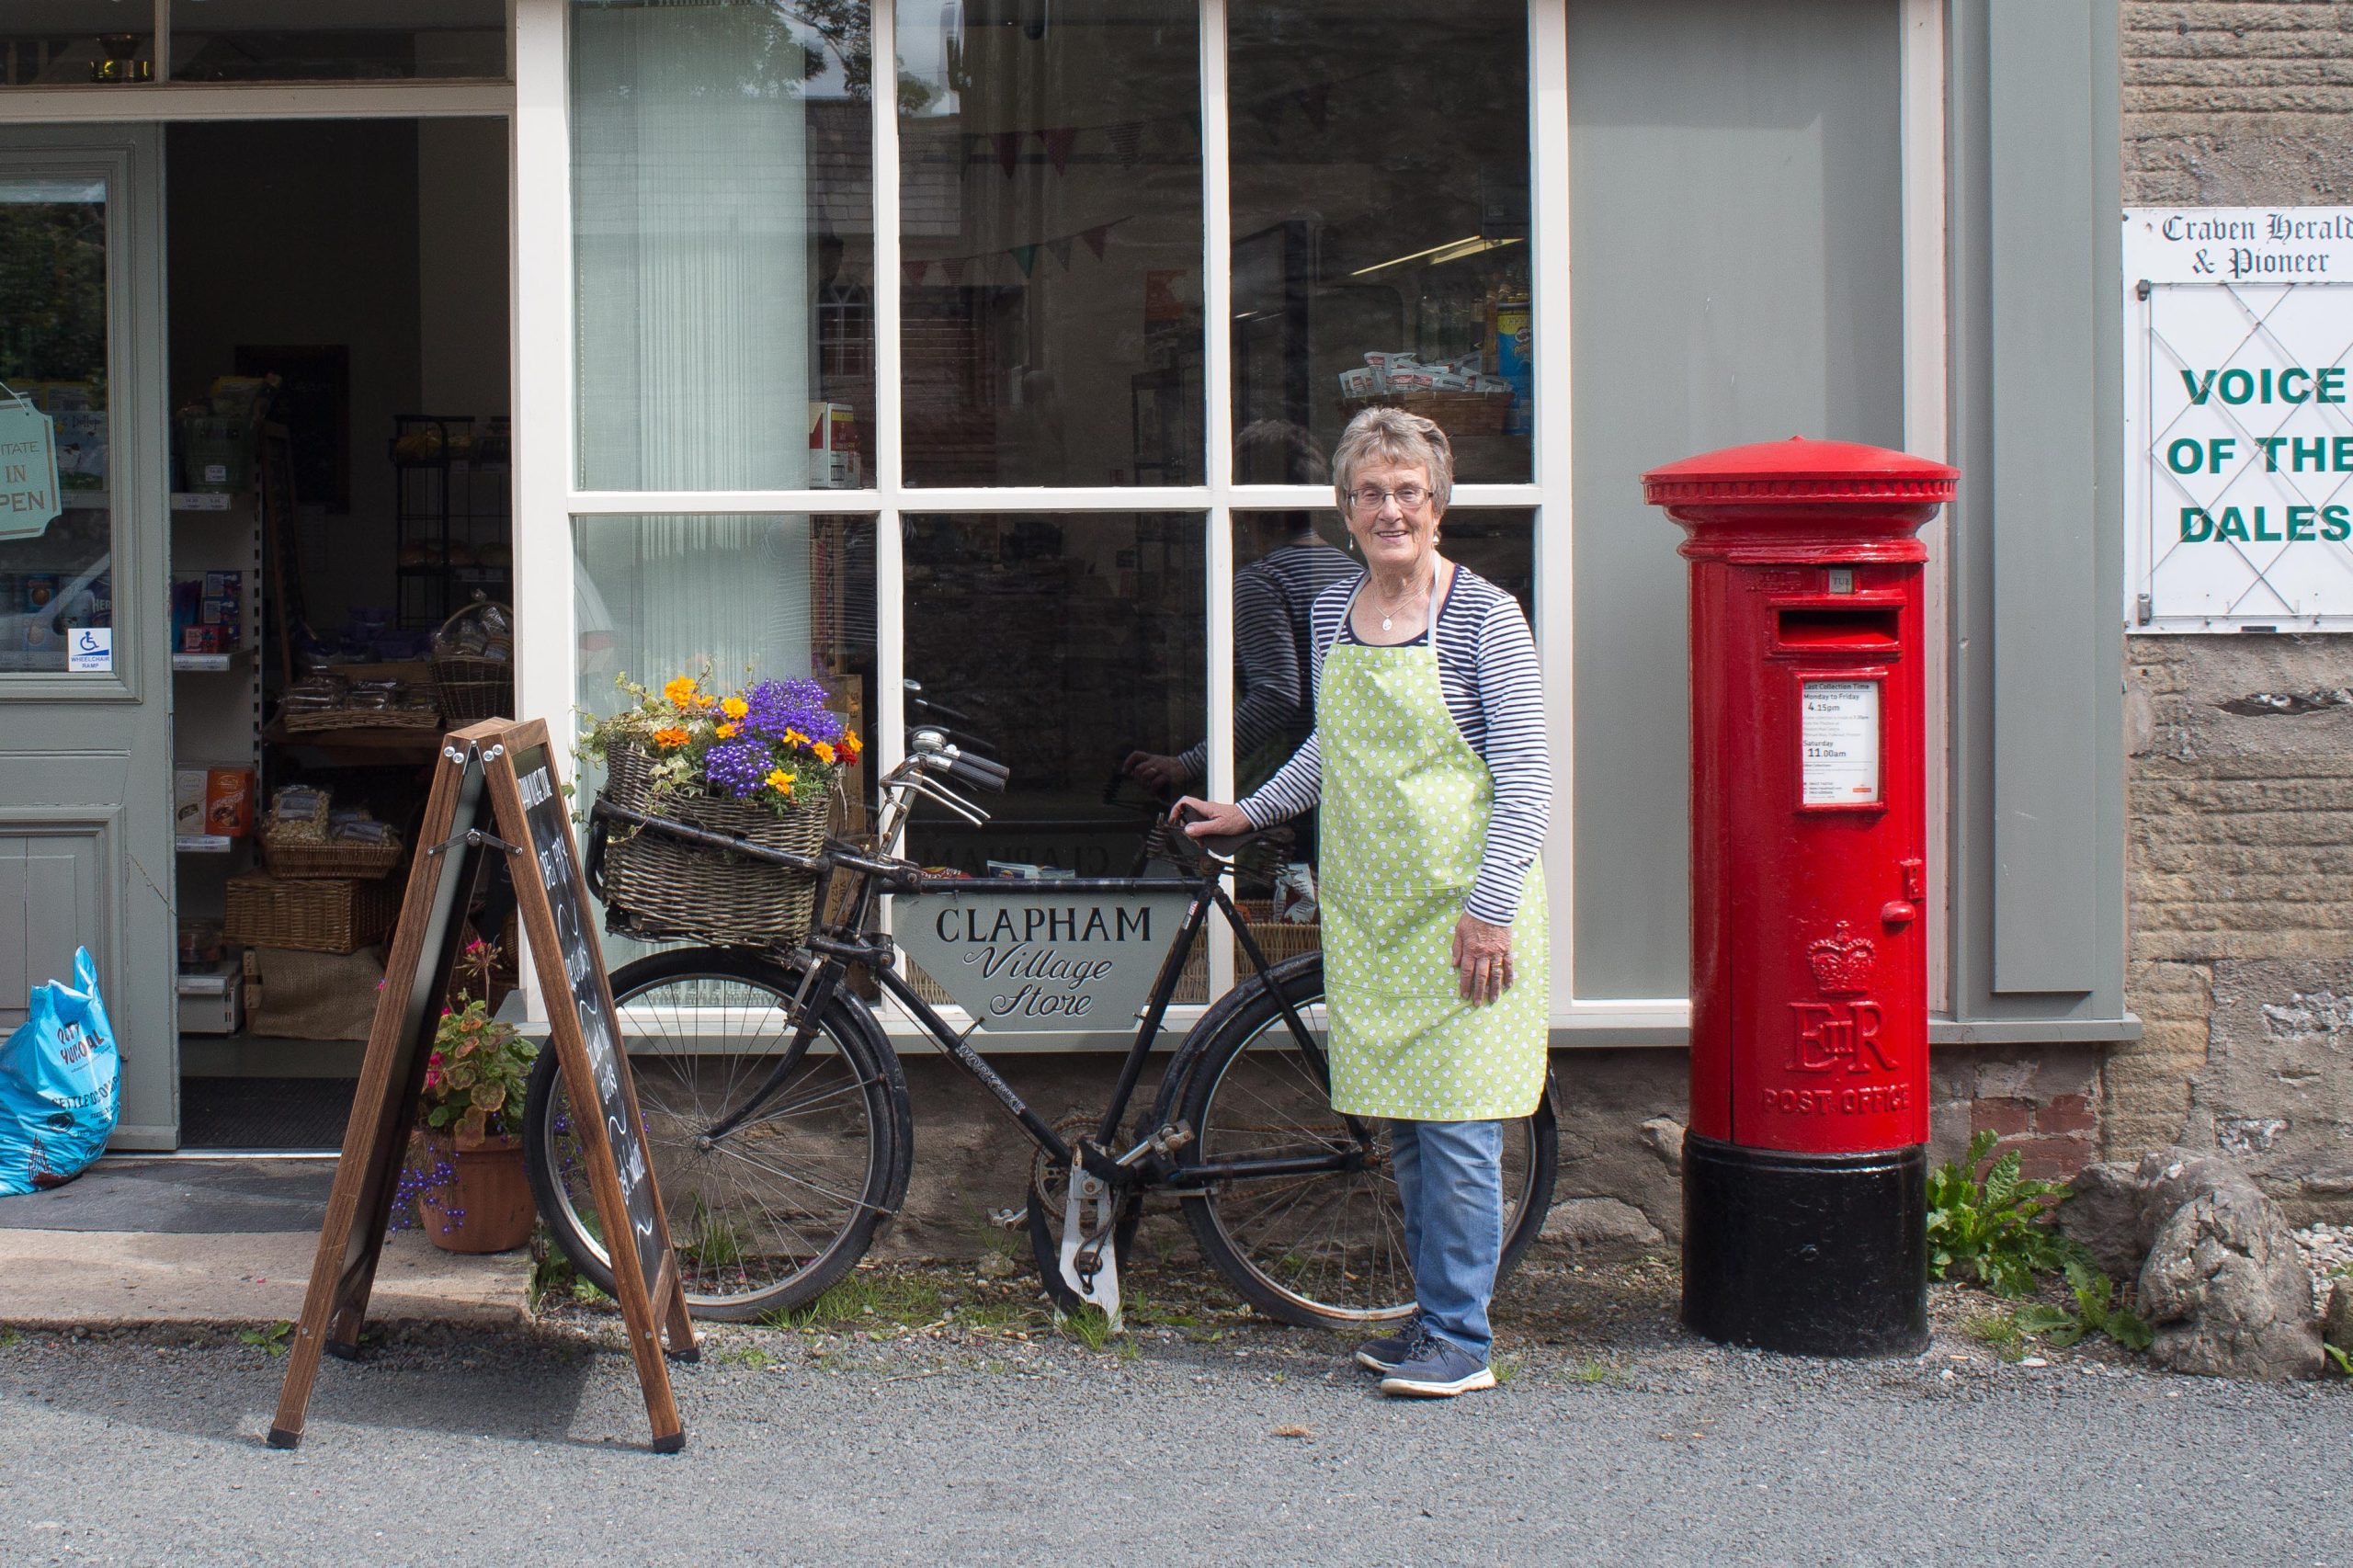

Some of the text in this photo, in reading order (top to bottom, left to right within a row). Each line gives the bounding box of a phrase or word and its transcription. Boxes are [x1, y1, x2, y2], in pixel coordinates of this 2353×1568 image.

[2162, 215, 2256, 242] Craven
[2191, 247, 2330, 279] & Pioneer
[2180, 368, 2346, 405] VOICE
[2166, 436, 2353, 474] OF THE
[5, 464, 27, 483] IN
[2179, 505, 2351, 542] DALES
[1807, 702, 1840, 712] 4.15pm
[1838, 693, 1860, 701] Friday
[1803, 739, 1834, 747] Saturday
[1807, 747, 1847, 757] 11.00am
[936, 906, 1152, 943] CLAPHAM
[963, 942, 1113, 992] Village
[990, 983, 1093, 1018] Store
[1762, 1082, 1911, 1116] POST OFFICE
